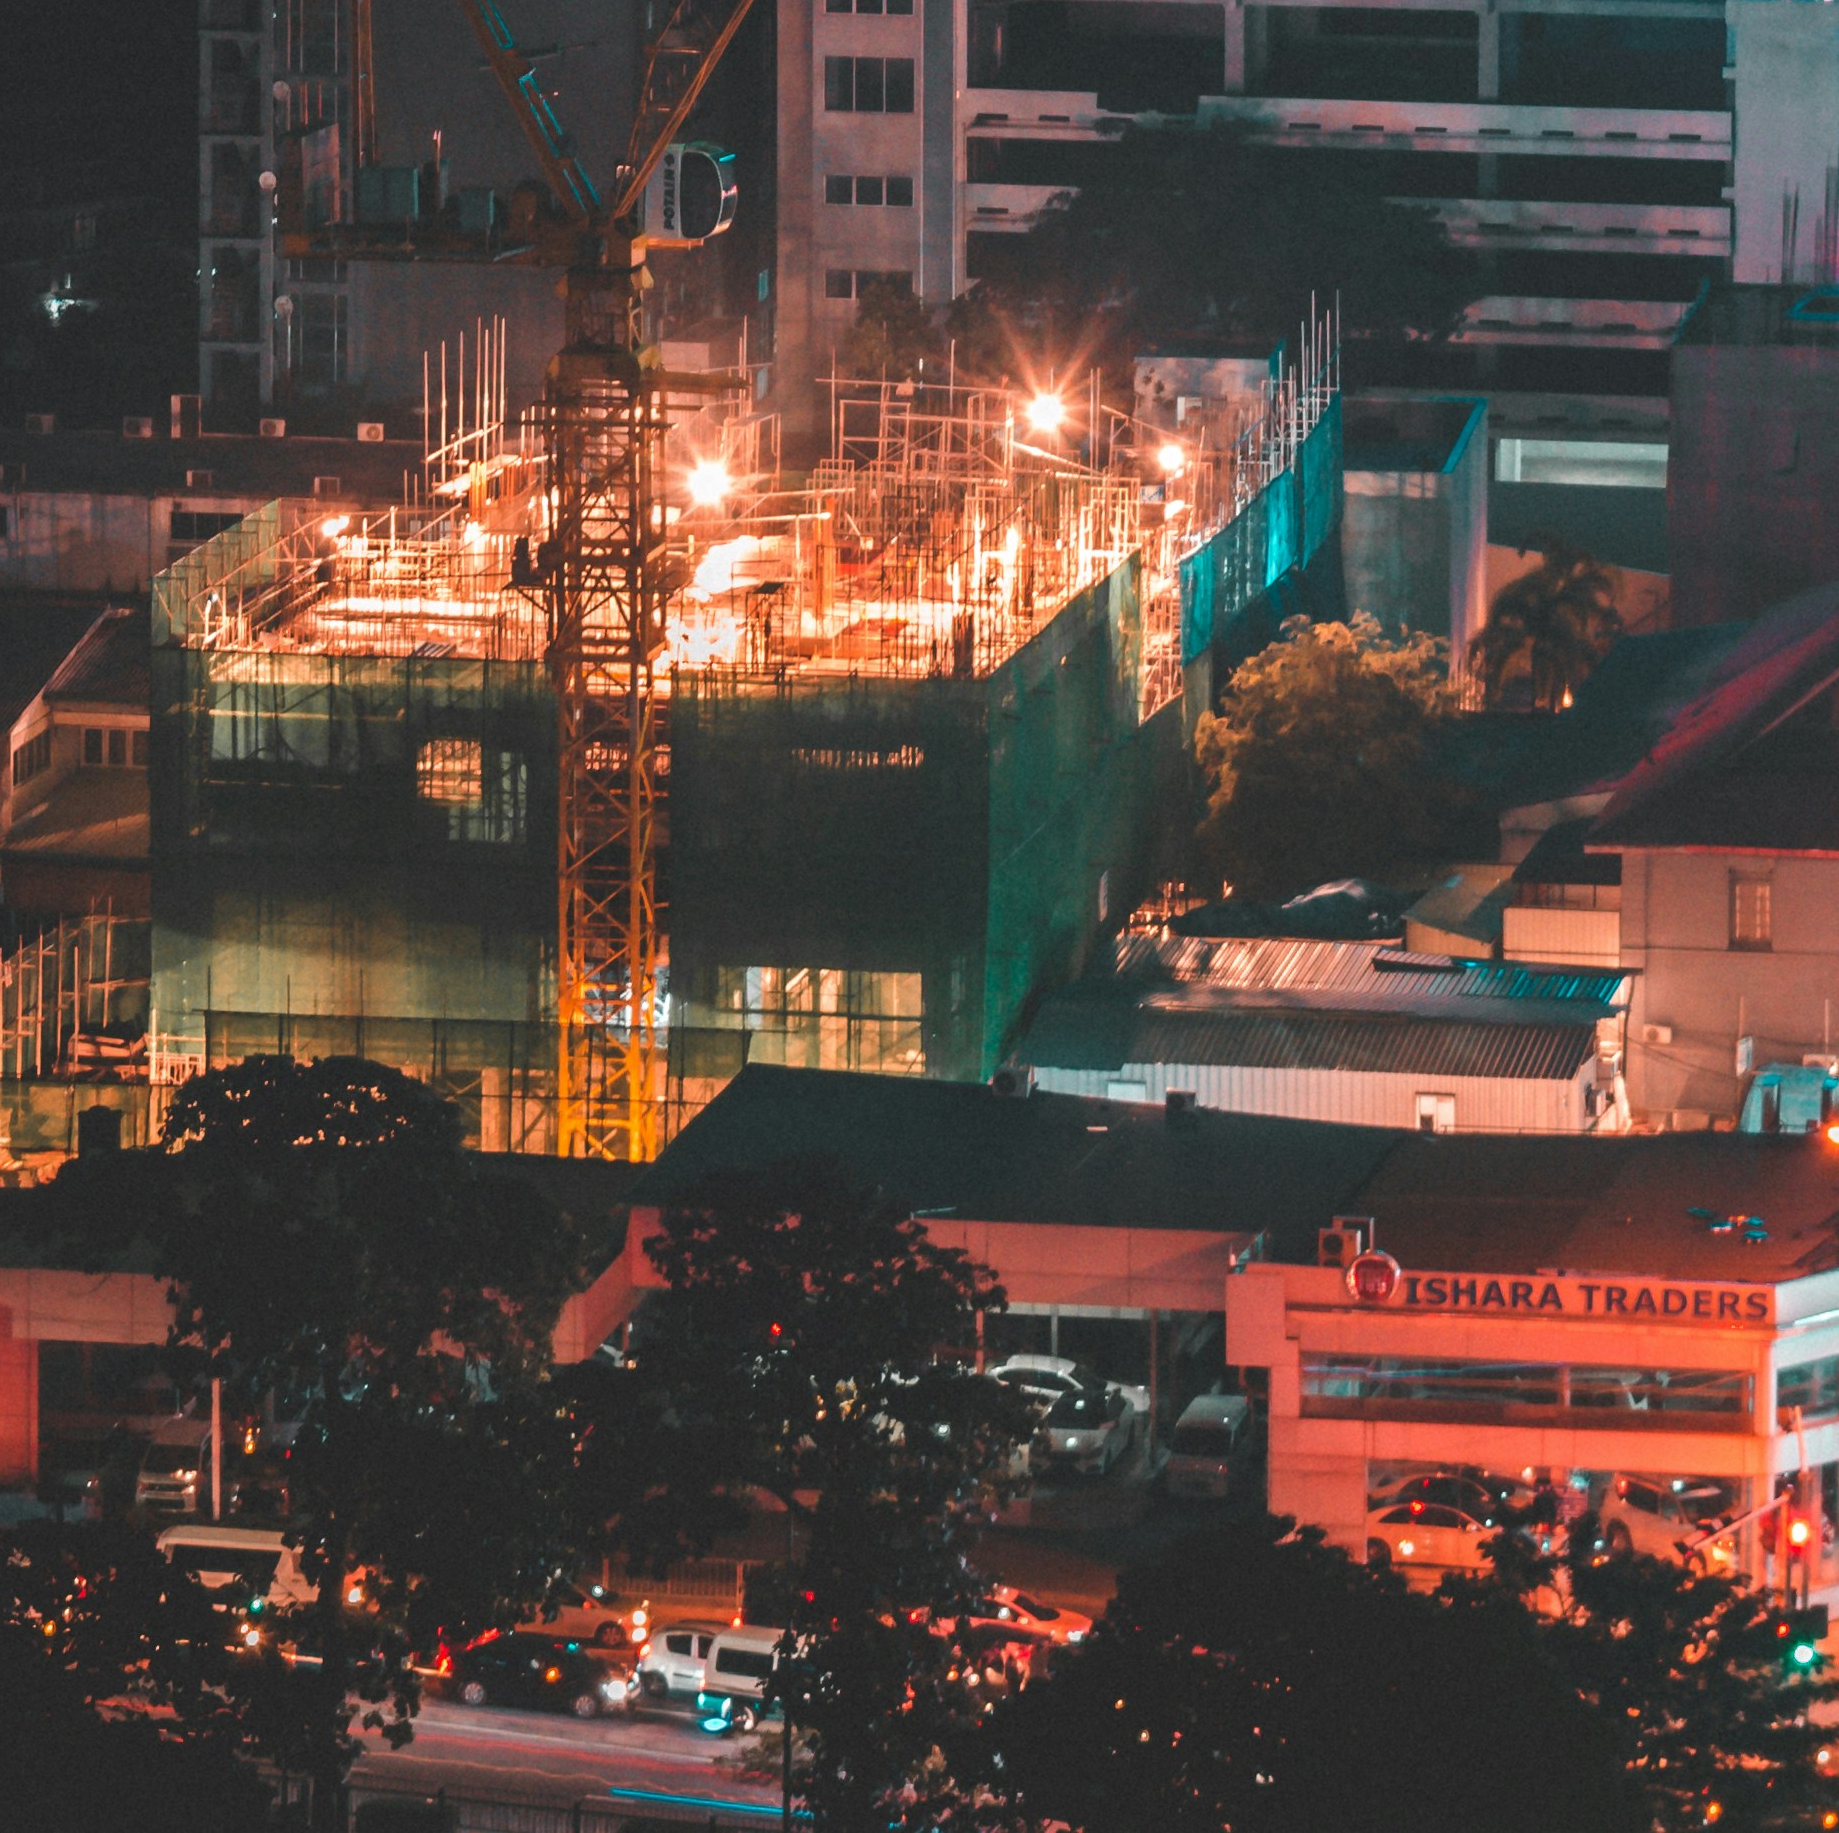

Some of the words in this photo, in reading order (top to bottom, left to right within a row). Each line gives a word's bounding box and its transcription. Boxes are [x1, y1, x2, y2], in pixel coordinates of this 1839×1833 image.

[664, 169, 675, 230] POTAIN
[1406, 1276, 1563, 1311] ISHARA
[1578, 1284, 1769, 1320] TRADERS
